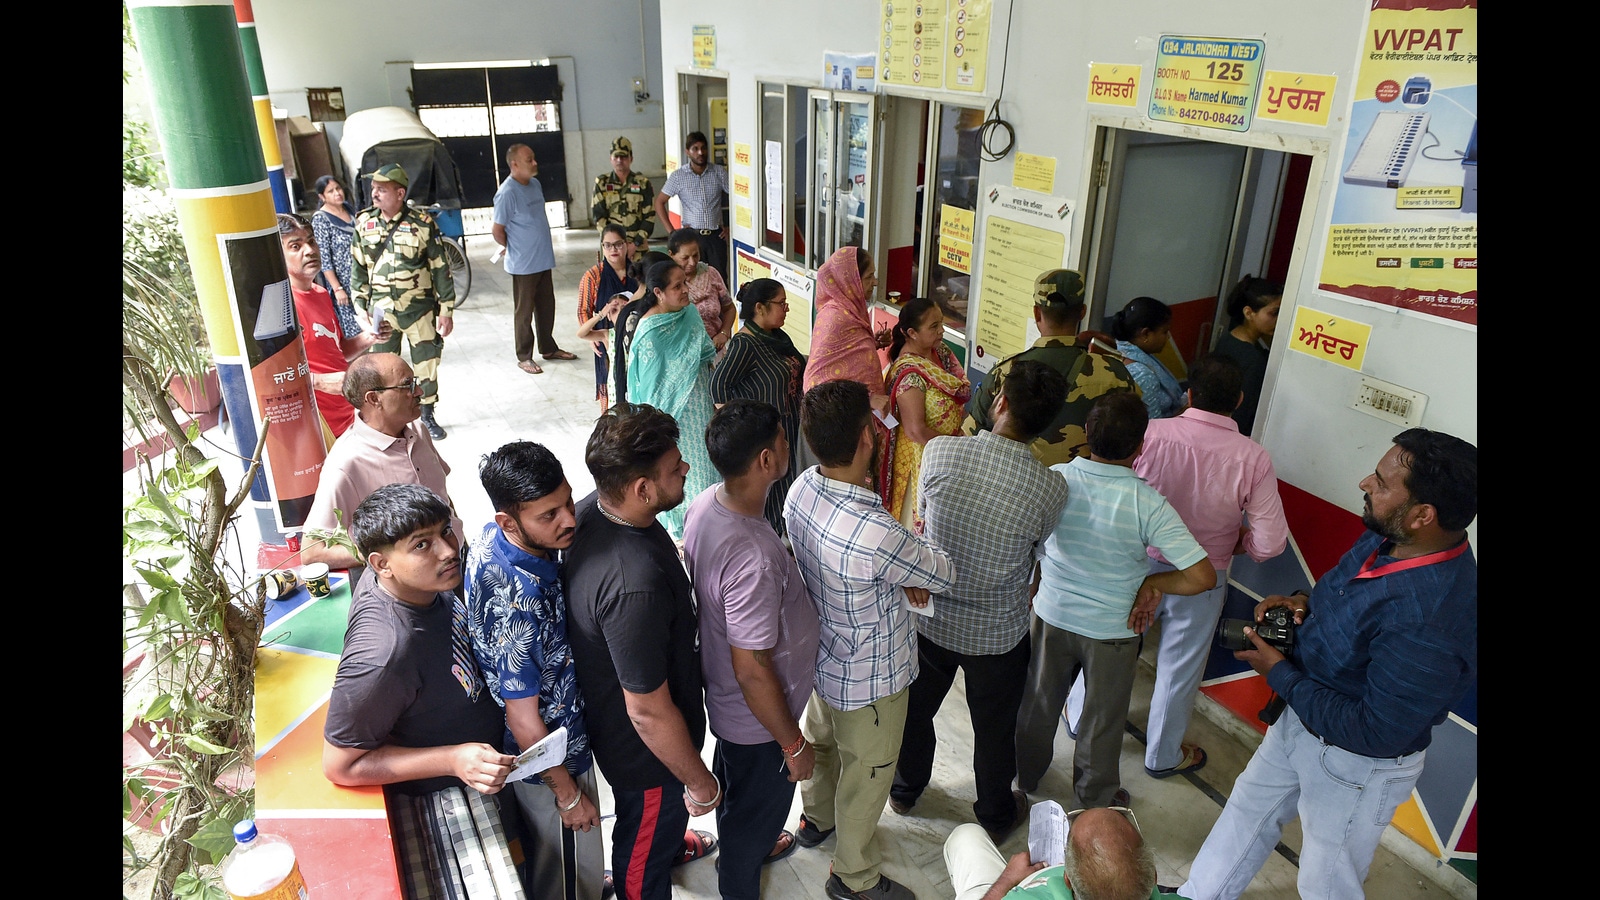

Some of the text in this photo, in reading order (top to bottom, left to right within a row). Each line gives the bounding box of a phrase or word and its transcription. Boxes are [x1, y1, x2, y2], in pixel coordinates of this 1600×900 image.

[1374, 28, 1463, 51] VVPAT
[1163, 41, 1256, 60] 034 JALANDHAR WEST
[1157, 61, 1244, 81] BOOTH NO 125
[1091, 75, 1135, 98] ਇਸਤਰੀ
[1174, 90, 1187, 102] Name
[1189, 88, 1219, 103] Harmed
[1221, 91, 1248, 106] Kumar
[1267, 86, 1326, 114] ਪੁਰਸ਼
[1152, 103, 1166, 115] Phone
[1179, 108, 1245, 126] 84270-08424
[947, 252, 962, 263] CCTV
[957, 249, 970, 258] UNDER
[1299, 324, 1359, 360] ਅੰਦਰ
[273, 366, 295, 385] ਜਾਣੋ
